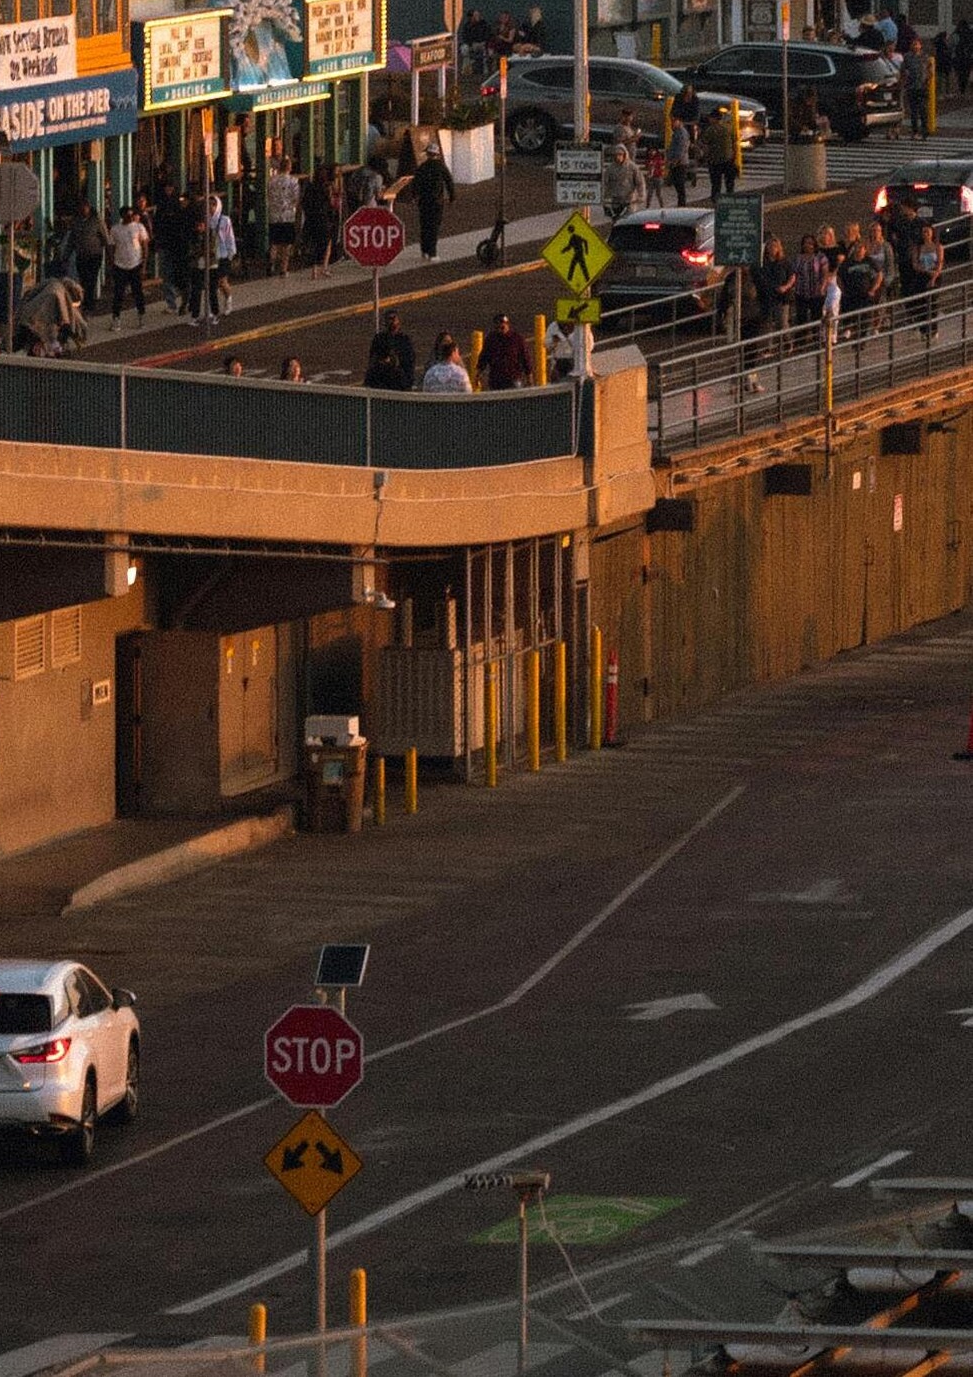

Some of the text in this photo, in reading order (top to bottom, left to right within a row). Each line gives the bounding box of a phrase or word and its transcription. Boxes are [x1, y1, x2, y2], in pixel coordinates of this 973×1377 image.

[13, 27, 41, 53] Serving
[43, 24, 70, 49] Brunch
[22, 52, 58, 77] Weekends
[50, 95, 67, 121] ON
[68, 91, 87, 117] THE
[88, 87, 112, 114] PIER
[560, 161, 598, 170] 15 TONS
[562, 191, 596, 201] 3 TONS
[348, 225, 400, 248] STOP
[272, 1037, 356, 1075] STOP
